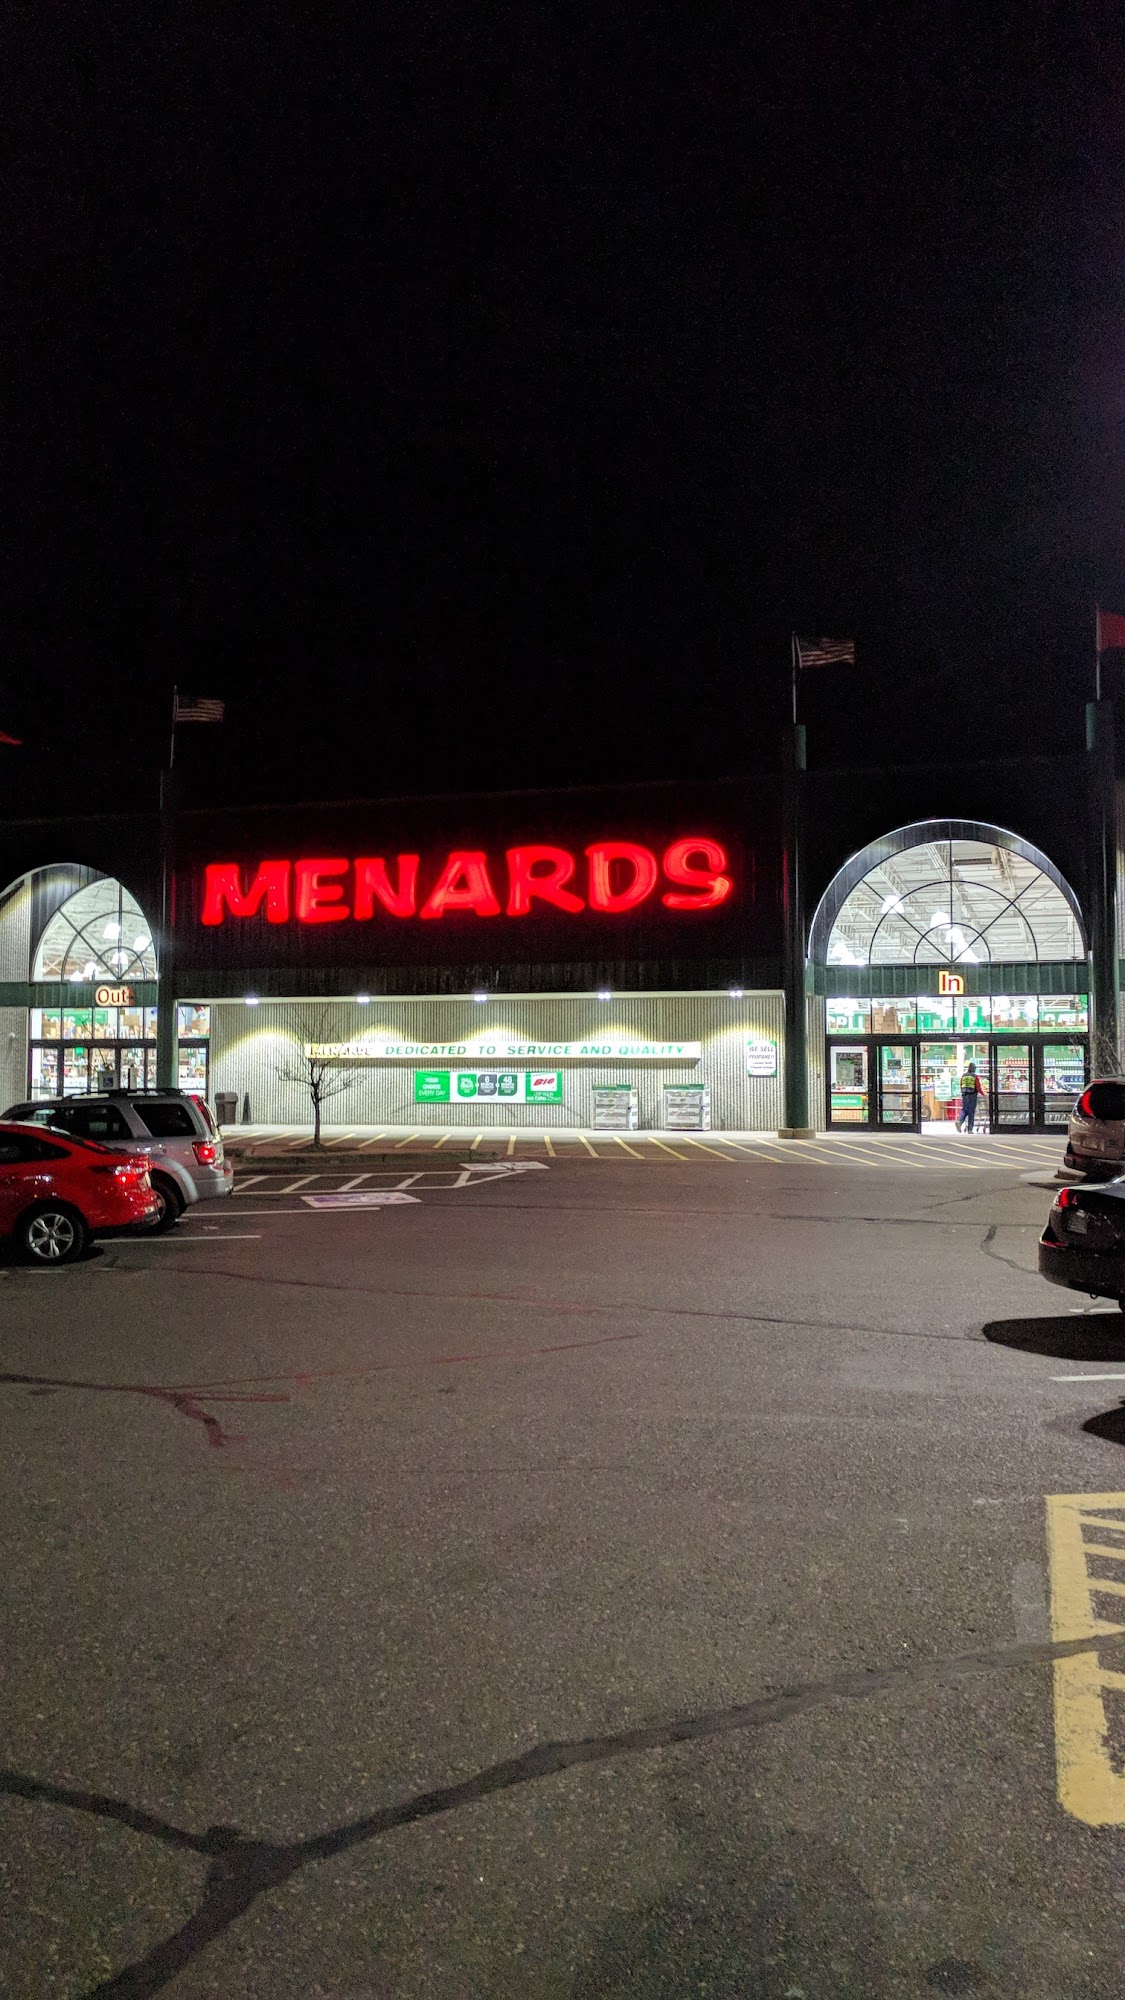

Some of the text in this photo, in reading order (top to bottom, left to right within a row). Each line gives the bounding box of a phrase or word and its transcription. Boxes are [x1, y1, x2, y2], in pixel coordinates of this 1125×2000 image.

[201, 837, 732, 925] MENARDS
[941, 973, 962, 993] In
[96, 987, 128, 1005] Out
[385, 1045, 467, 1055] DEDICATED
[479, 1045, 497, 1055] TO
[507, 1045, 572, 1055] SERVICE
[580, 1045, 612, 1055] AND
[618, 1045, 685, 1056] QUALITY
